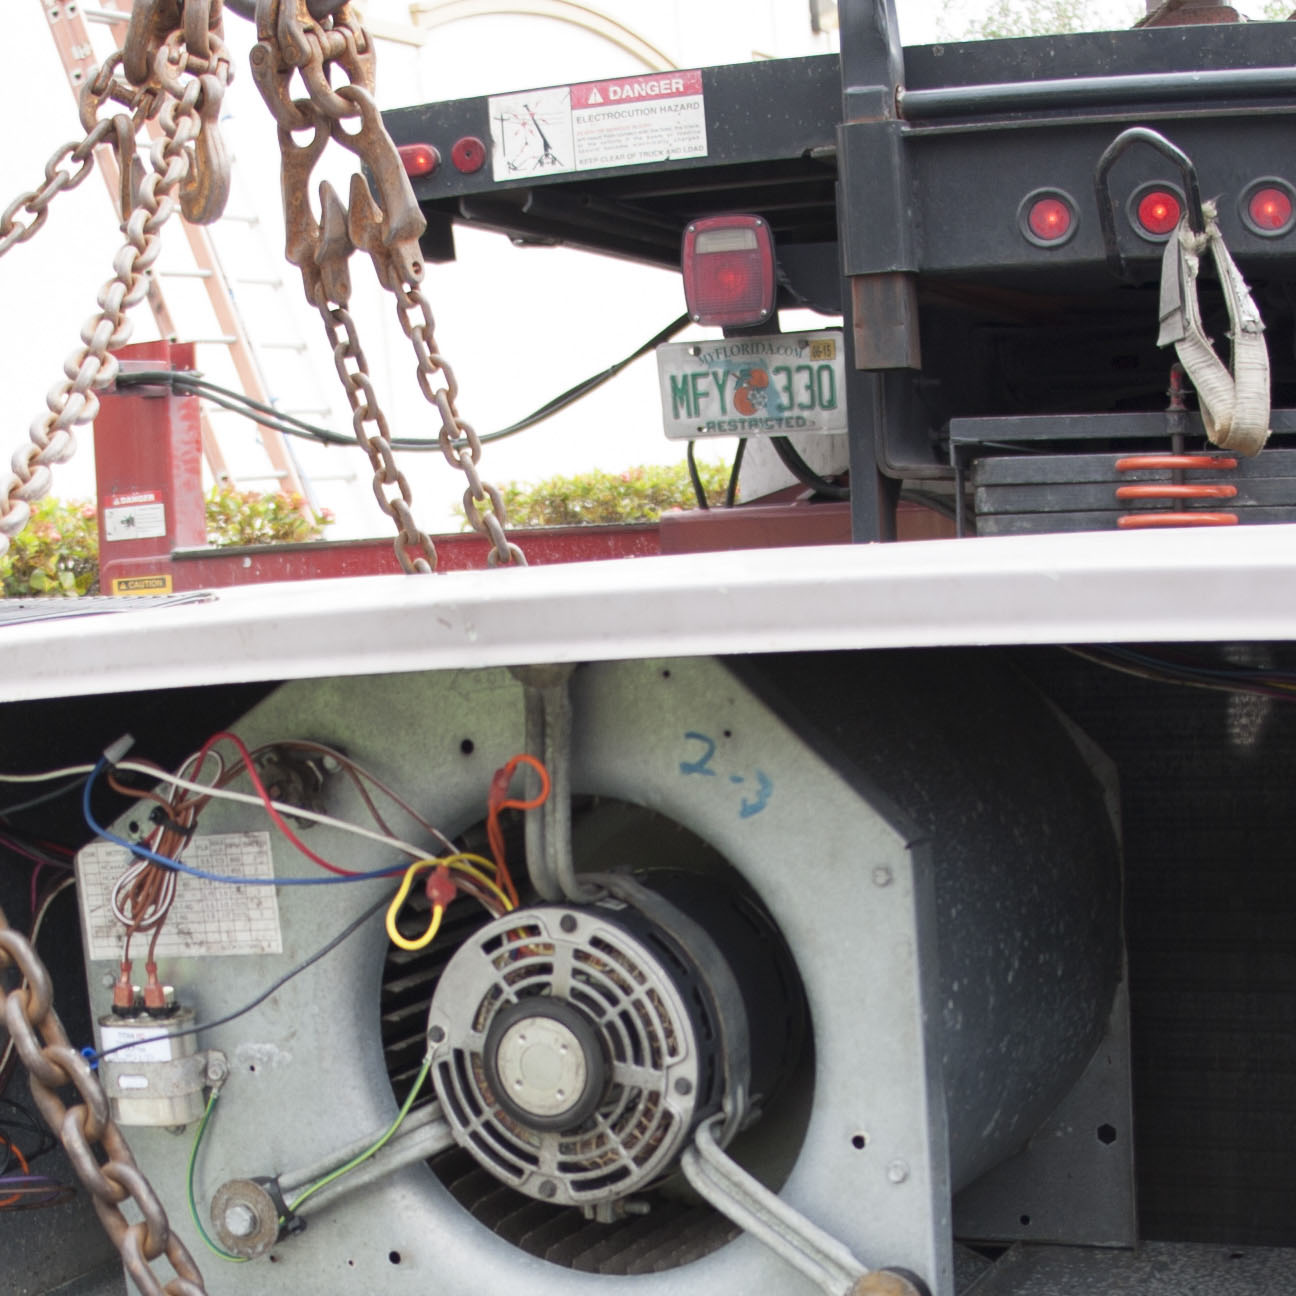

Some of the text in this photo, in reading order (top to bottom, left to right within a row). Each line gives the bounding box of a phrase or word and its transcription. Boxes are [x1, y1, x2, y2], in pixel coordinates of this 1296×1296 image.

[608, 78, 684, 100] DANGER
[576, 102, 700, 124] ELECTROCUTION HAZARD
[600, 154, 625, 163] CLEAR
[639, 149, 664, 159] TRUCK
[666, 147, 681, 156] AND
[683, 145, 704, 154] LOAD
[669, 370, 731, 420] MFY
[705, 416, 805, 433] RESTRICTED
[128, 578, 163, 590] CAUTION
